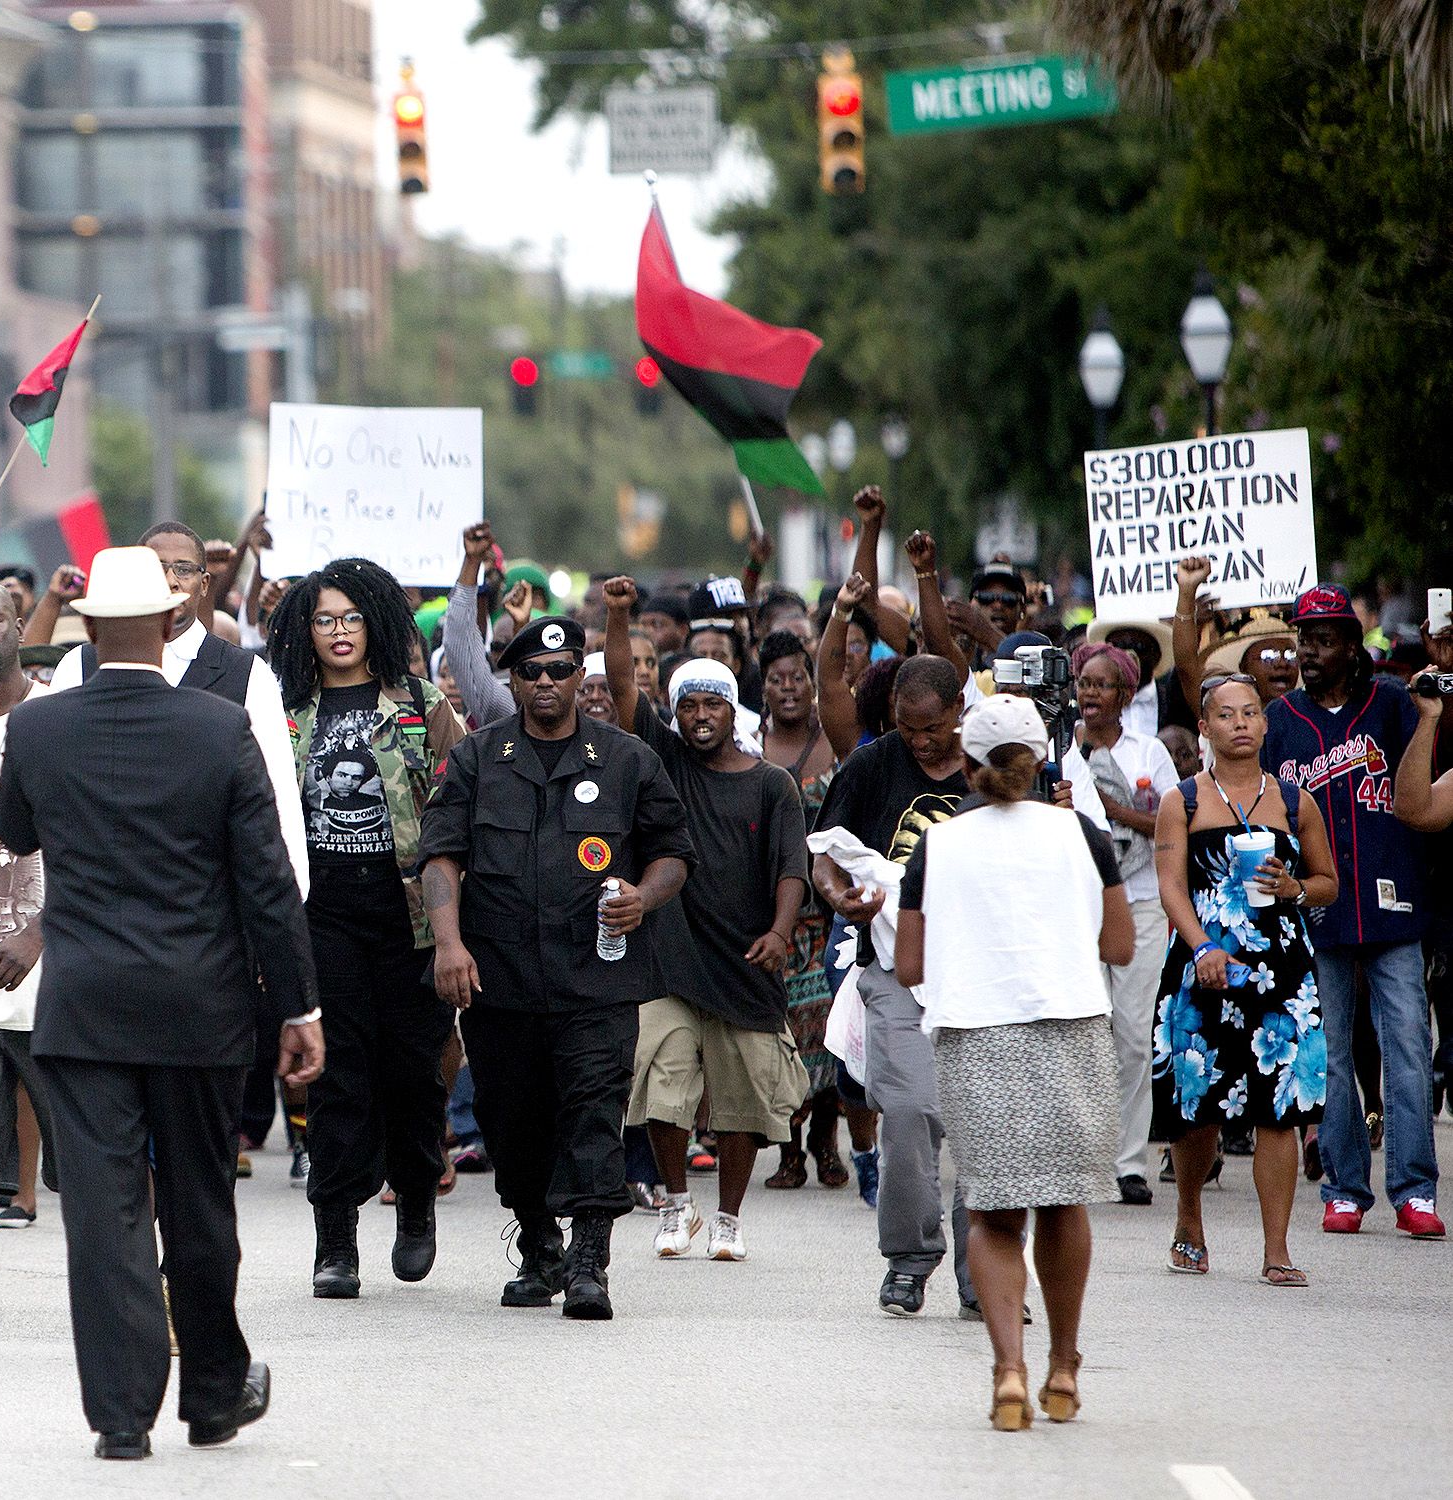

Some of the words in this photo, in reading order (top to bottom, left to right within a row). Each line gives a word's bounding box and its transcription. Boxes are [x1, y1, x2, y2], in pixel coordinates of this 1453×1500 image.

[911, 67, 1052, 122] MEETING
[288, 416, 334, 470] No
[346, 425, 403, 469] One
[1089, 438, 1256, 488] $300,000
[280, 487, 331, 521] The
[345, 487, 396, 521] Race
[1091, 472, 1299, 523] REPARATION
[1095, 512, 1246, 559] AFRICAN
[1098, 548, 1265, 598] AMERCAN
[1280, 734, 1364, 788] Braves
[354, 806, 387, 820] POWER
[1357, 776, 1394, 813] 44
[330, 832, 379, 843] PANTHER
